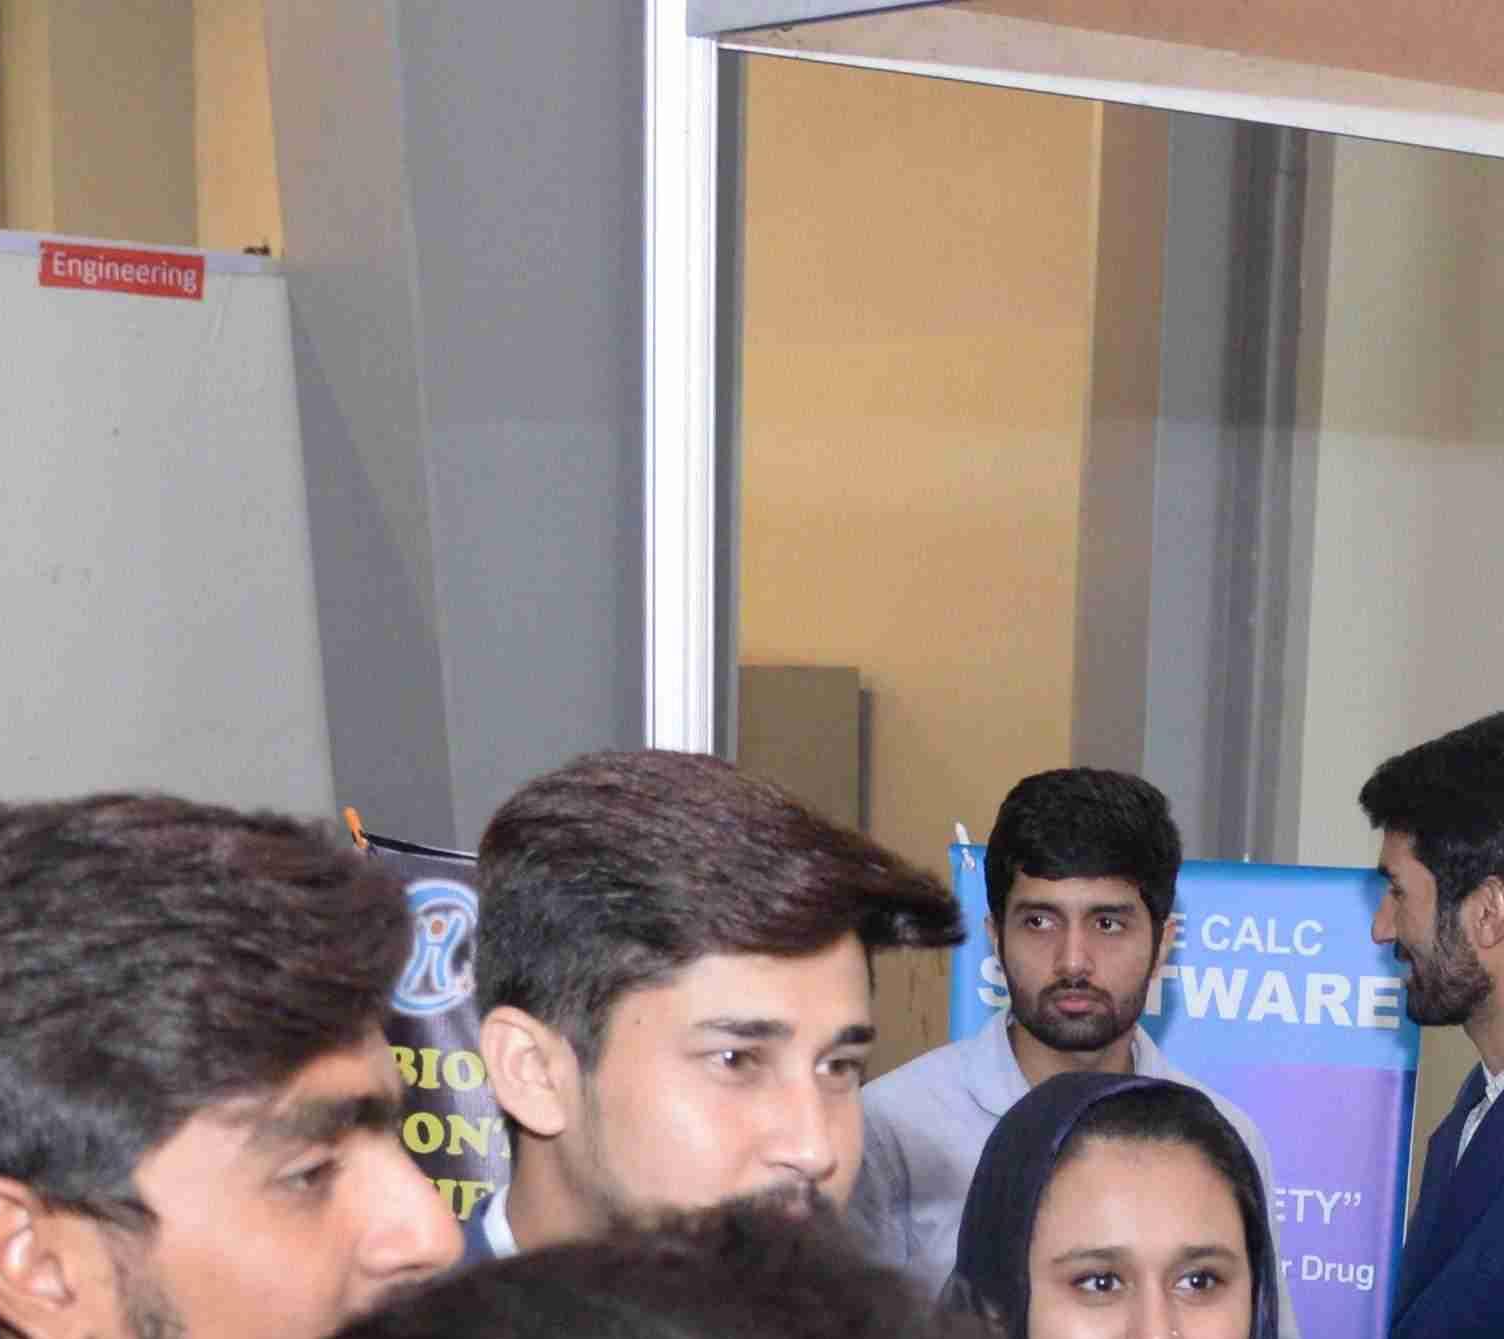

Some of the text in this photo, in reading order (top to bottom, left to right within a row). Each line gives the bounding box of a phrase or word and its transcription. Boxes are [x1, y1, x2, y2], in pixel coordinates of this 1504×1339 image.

[52, 250, 197, 294] Engineering
[1201, 913, 1324, 957] CALC
[976, 957, 1402, 1030] STWARE
[1301, 1254, 1376, 1292] Drug
